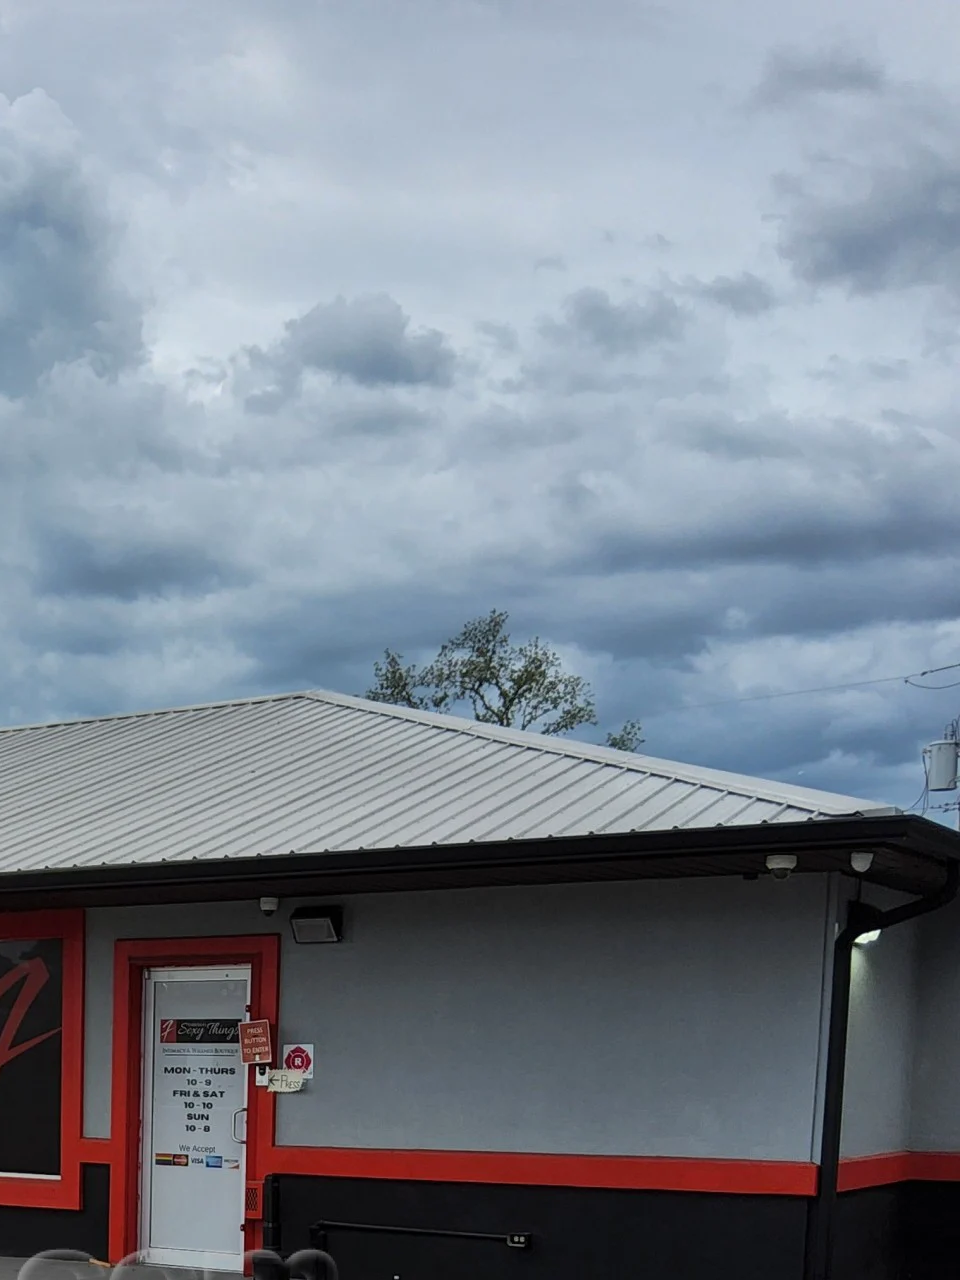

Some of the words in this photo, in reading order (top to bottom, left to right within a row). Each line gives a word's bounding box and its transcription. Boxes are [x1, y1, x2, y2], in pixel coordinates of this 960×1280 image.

[177, 1022, 204, 1040] Sexy
[206, 1022, 239, 1040] Things
[294, 1057, 302, 1066] R
[163, 1066, 191, 1075] MON
[198, 1067, 236, 1075] THURS
[202, 1090, 226, 1098] SAT
[186, 1113, 210, 1121] SUN
[179, 1144, 191, 1152] We
[192, 1145, 216, 1154] Accept
